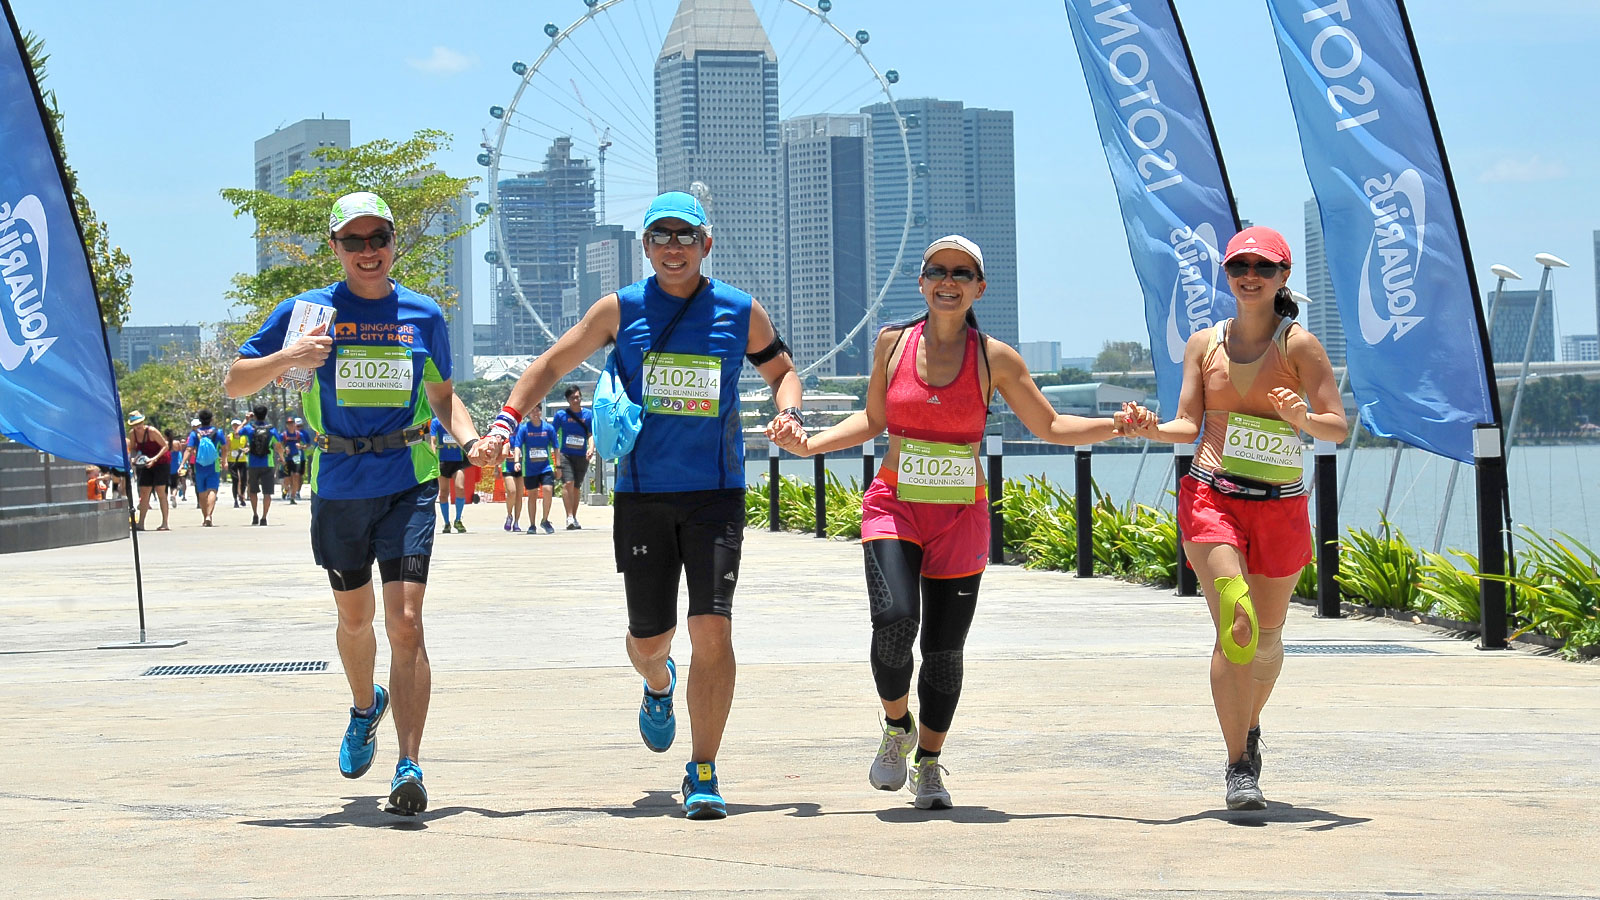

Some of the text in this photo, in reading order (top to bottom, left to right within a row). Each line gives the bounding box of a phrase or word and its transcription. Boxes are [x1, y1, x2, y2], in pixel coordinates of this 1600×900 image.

[360, 323, 414, 334] SINGAPORE
[360, 334, 384, 342] CITY
[387, 334, 414, 344] RACE
[347, 381, 403, 389] COOL RUNNINGS
[653, 388, 709, 398] COOL RUNNINGS
[1234, 449, 1293, 466] COOL RUNNINGS
[908, 476, 965, 486] COOL RUNNINGS
